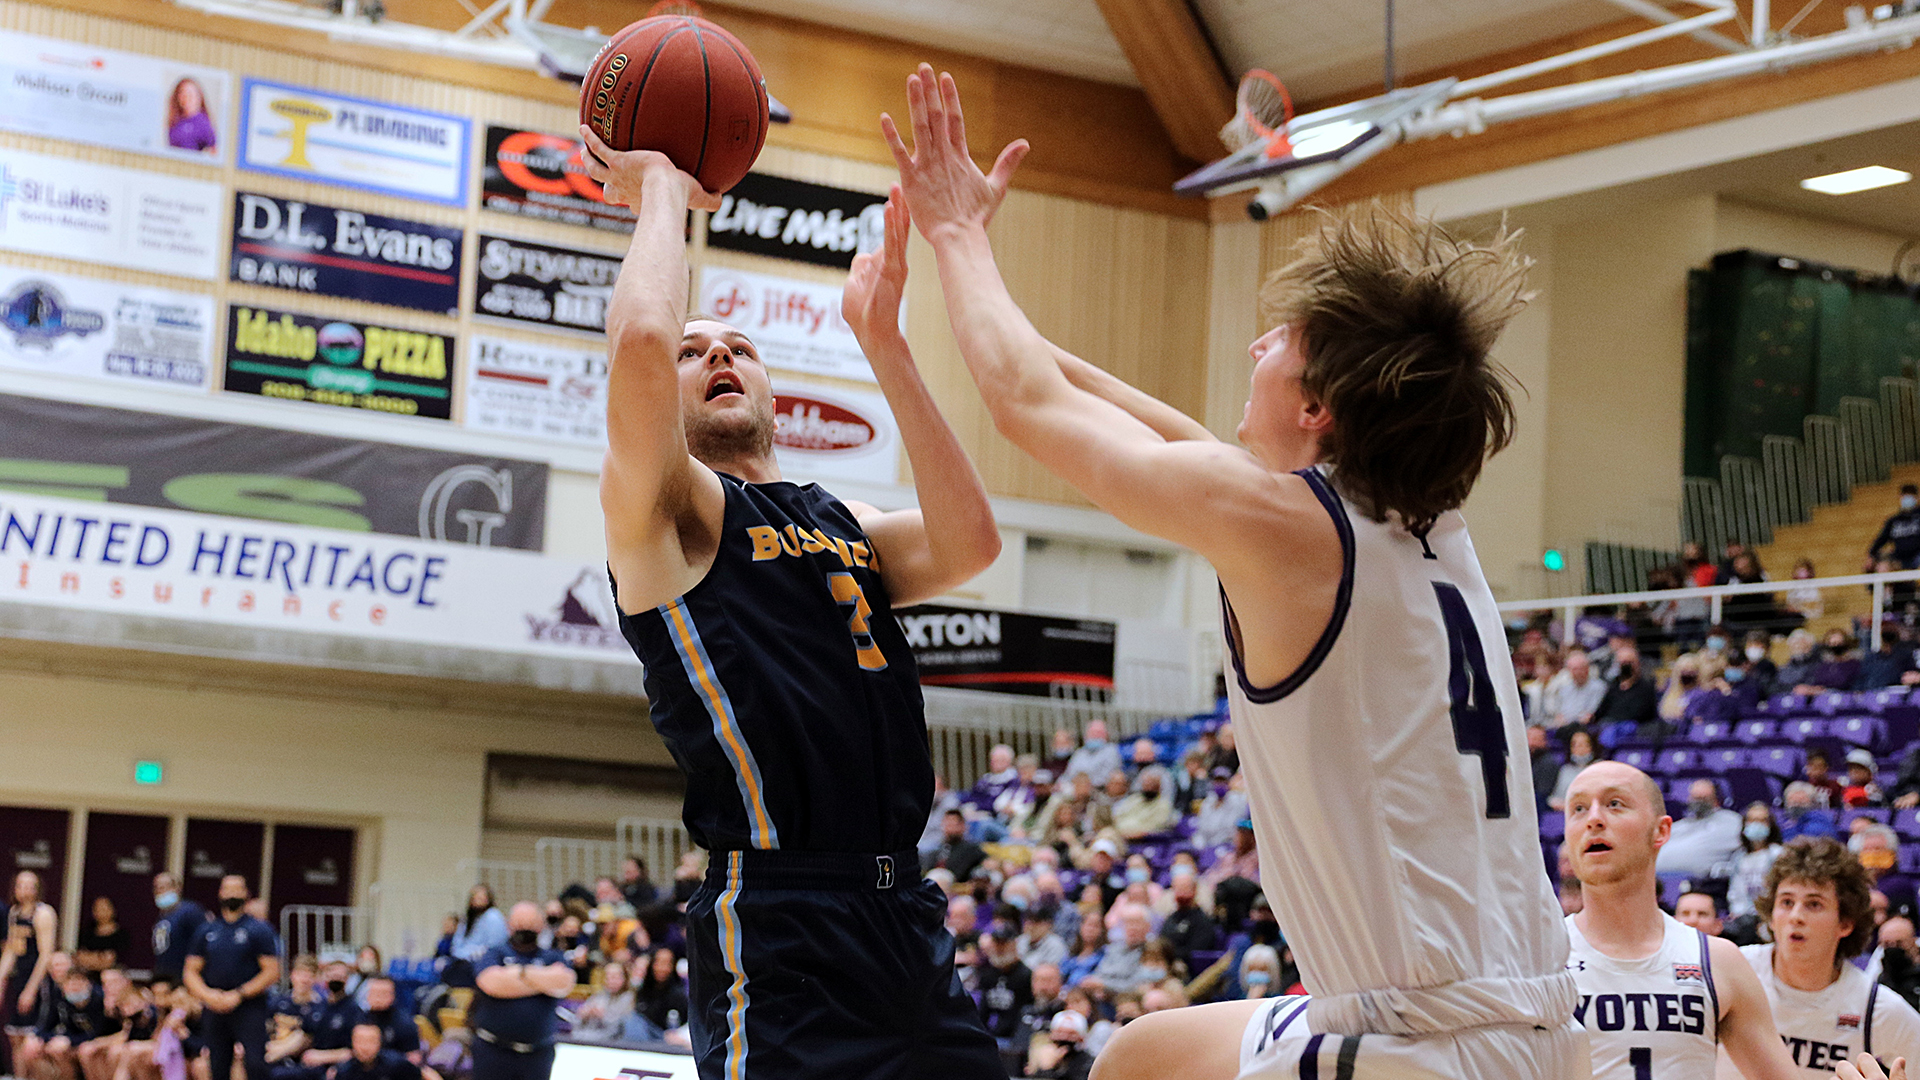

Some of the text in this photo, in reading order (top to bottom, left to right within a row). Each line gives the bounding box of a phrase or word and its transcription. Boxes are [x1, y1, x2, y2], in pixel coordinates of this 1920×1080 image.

[604, 95, 617, 143] LEGACY
[238, 195, 328, 250] D.L.
[333, 209, 453, 270] Evans
[710, 194, 788, 239] LIVE
[238, 257, 317, 290] BANK
[759, 287, 827, 335] jiffy
[235, 308, 317, 361] Idaho
[362, 326, 447, 380] PIZZA
[0, 512, 446, 607] NITED HERITAGE
[17, 562, 387, 625] Insurance
[826, 571, 889, 672] 3
[902, 612, 1000, 647] XTON
[1430, 580, 1511, 819] 4
[1573, 993, 1706, 1035] YOTES
[1629, 1047, 1653, 1080] 1
[1780, 1035, 1849, 1072] TES
